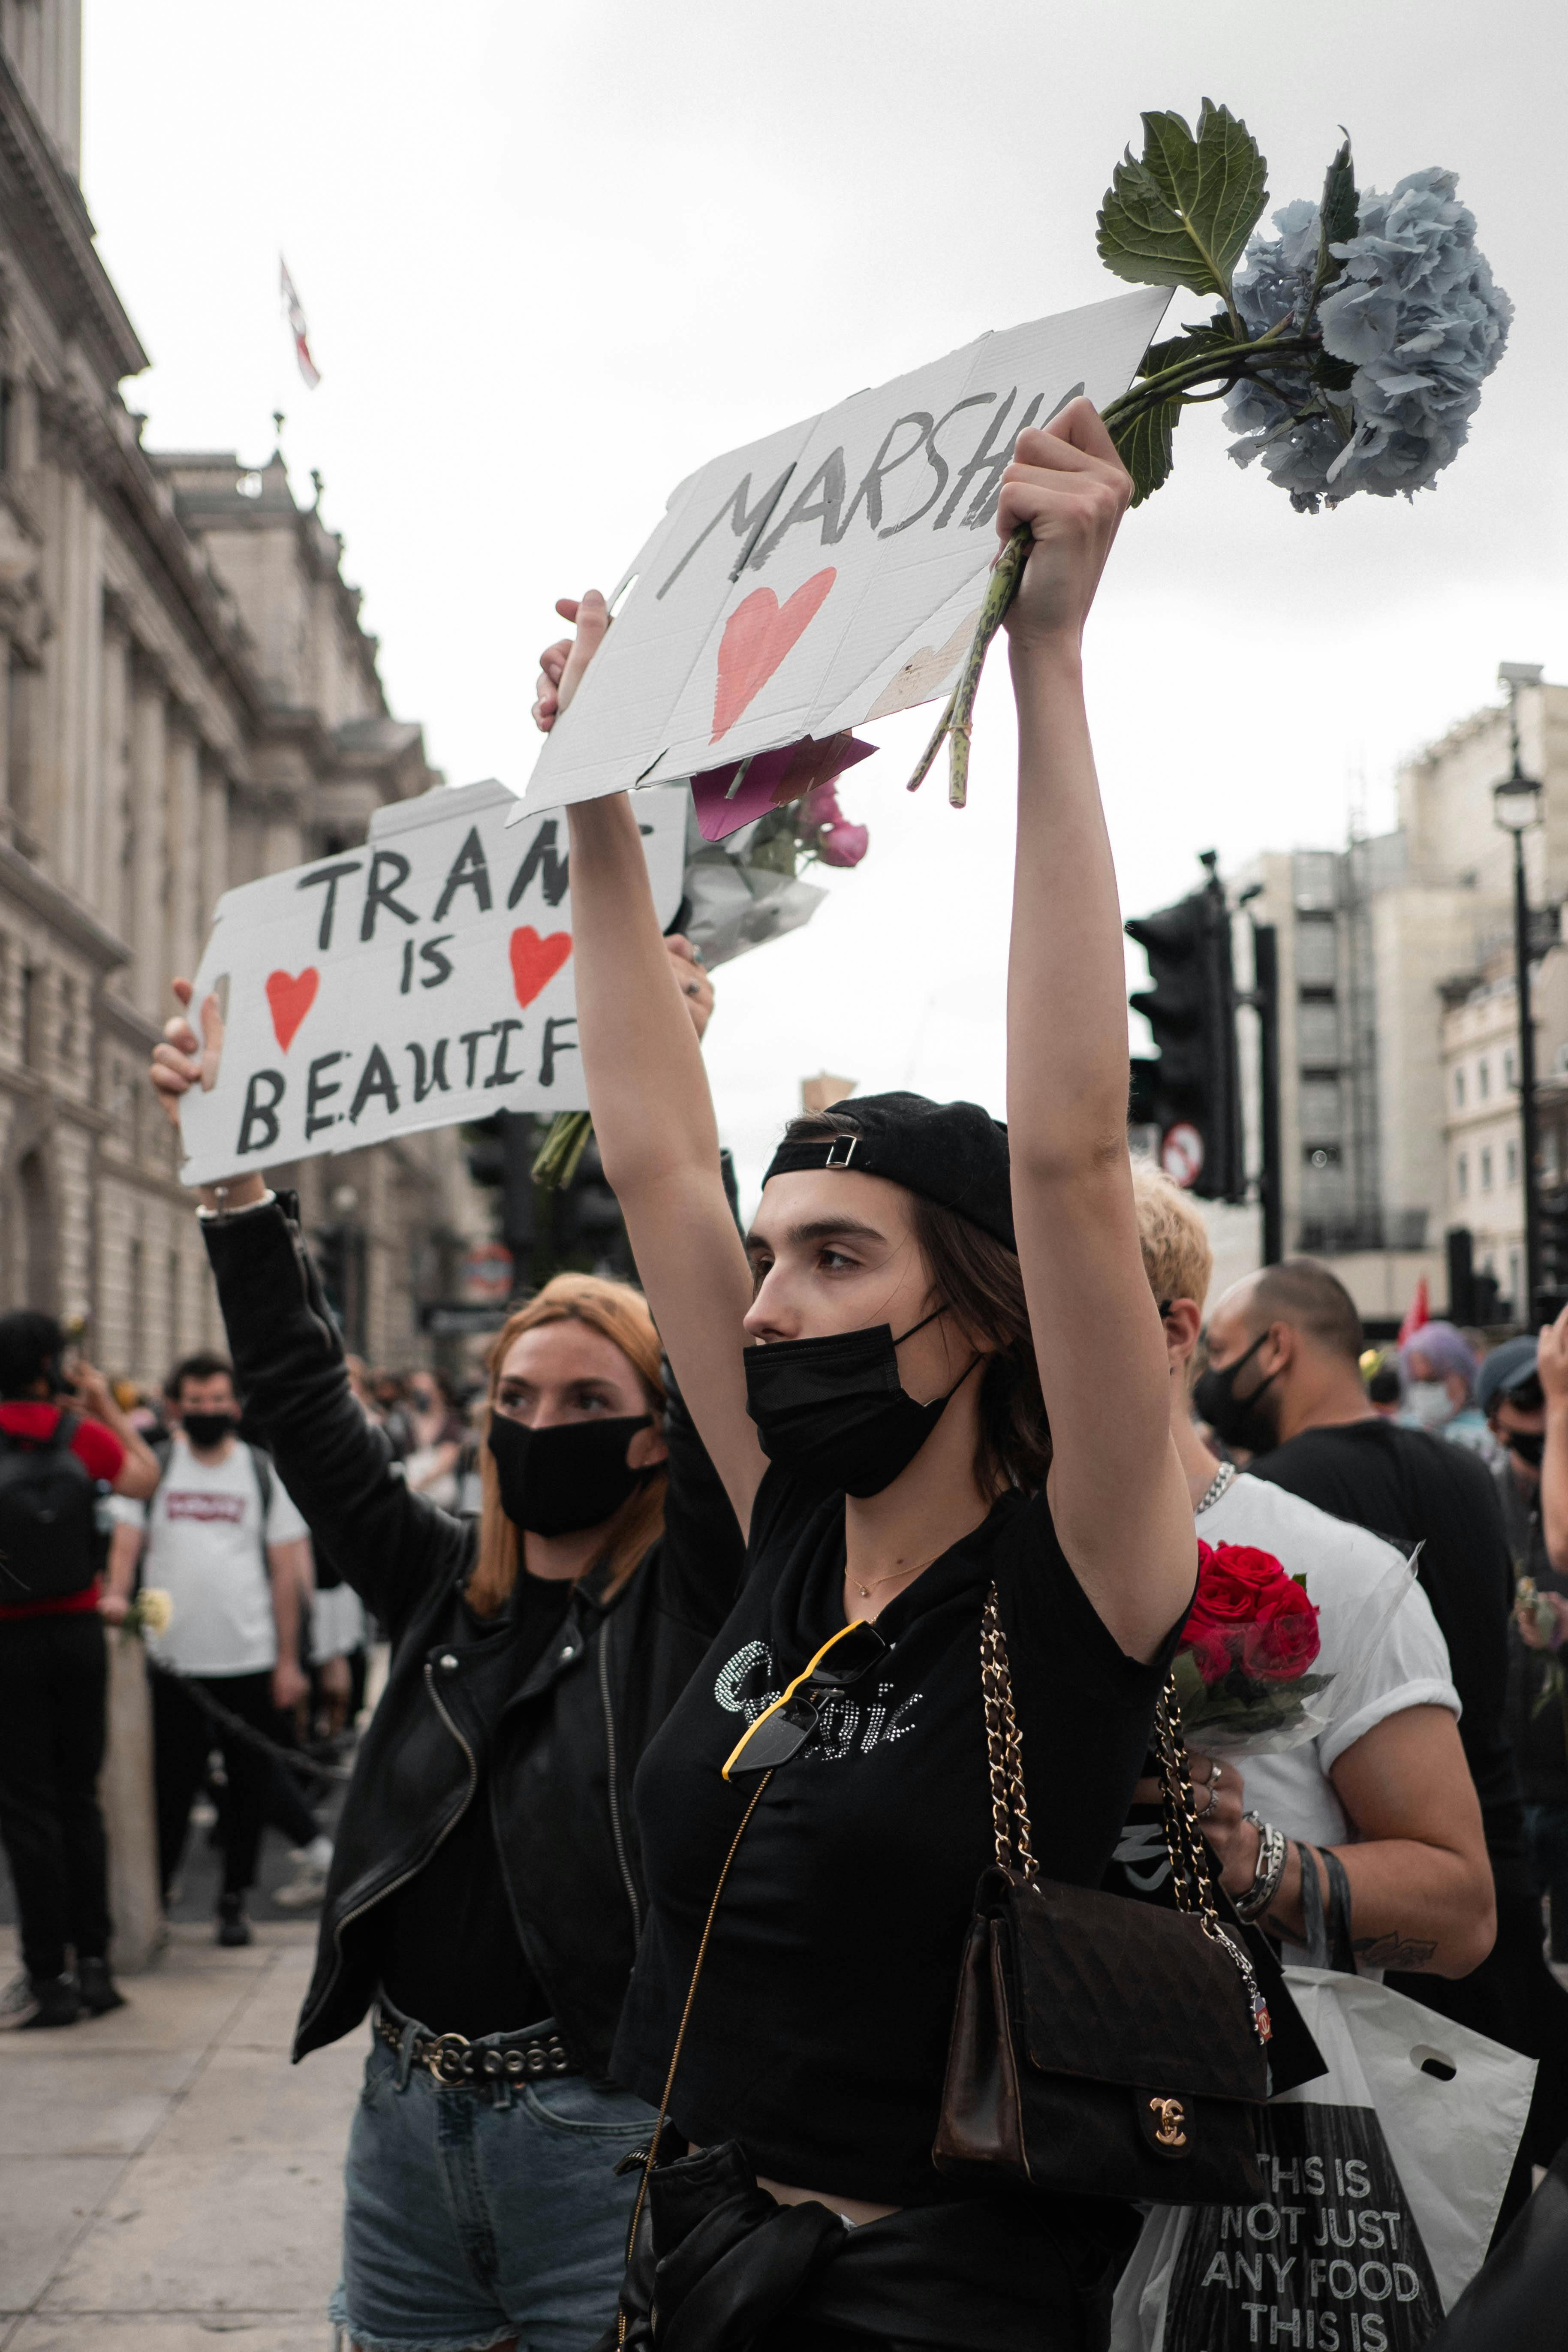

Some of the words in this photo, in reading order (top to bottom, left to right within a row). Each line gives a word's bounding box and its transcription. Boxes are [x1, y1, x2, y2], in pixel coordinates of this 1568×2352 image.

[296, 819, 654, 950] TRAN
[400, 934, 455, 994] IS
[235, 1017, 578, 1155] BEAUTIF
[1334, 2158, 1371, 2198] IS
[1220, 2202, 1306, 2244] NOT
[1314, 2207, 1401, 2250] JUST
[1201, 2251, 1297, 2293] ANY
[1310, 2259, 1420, 2301] FOOD
[1241, 2301, 1339, 2352] THIS
[1350, 2313, 1388, 2352] IS
